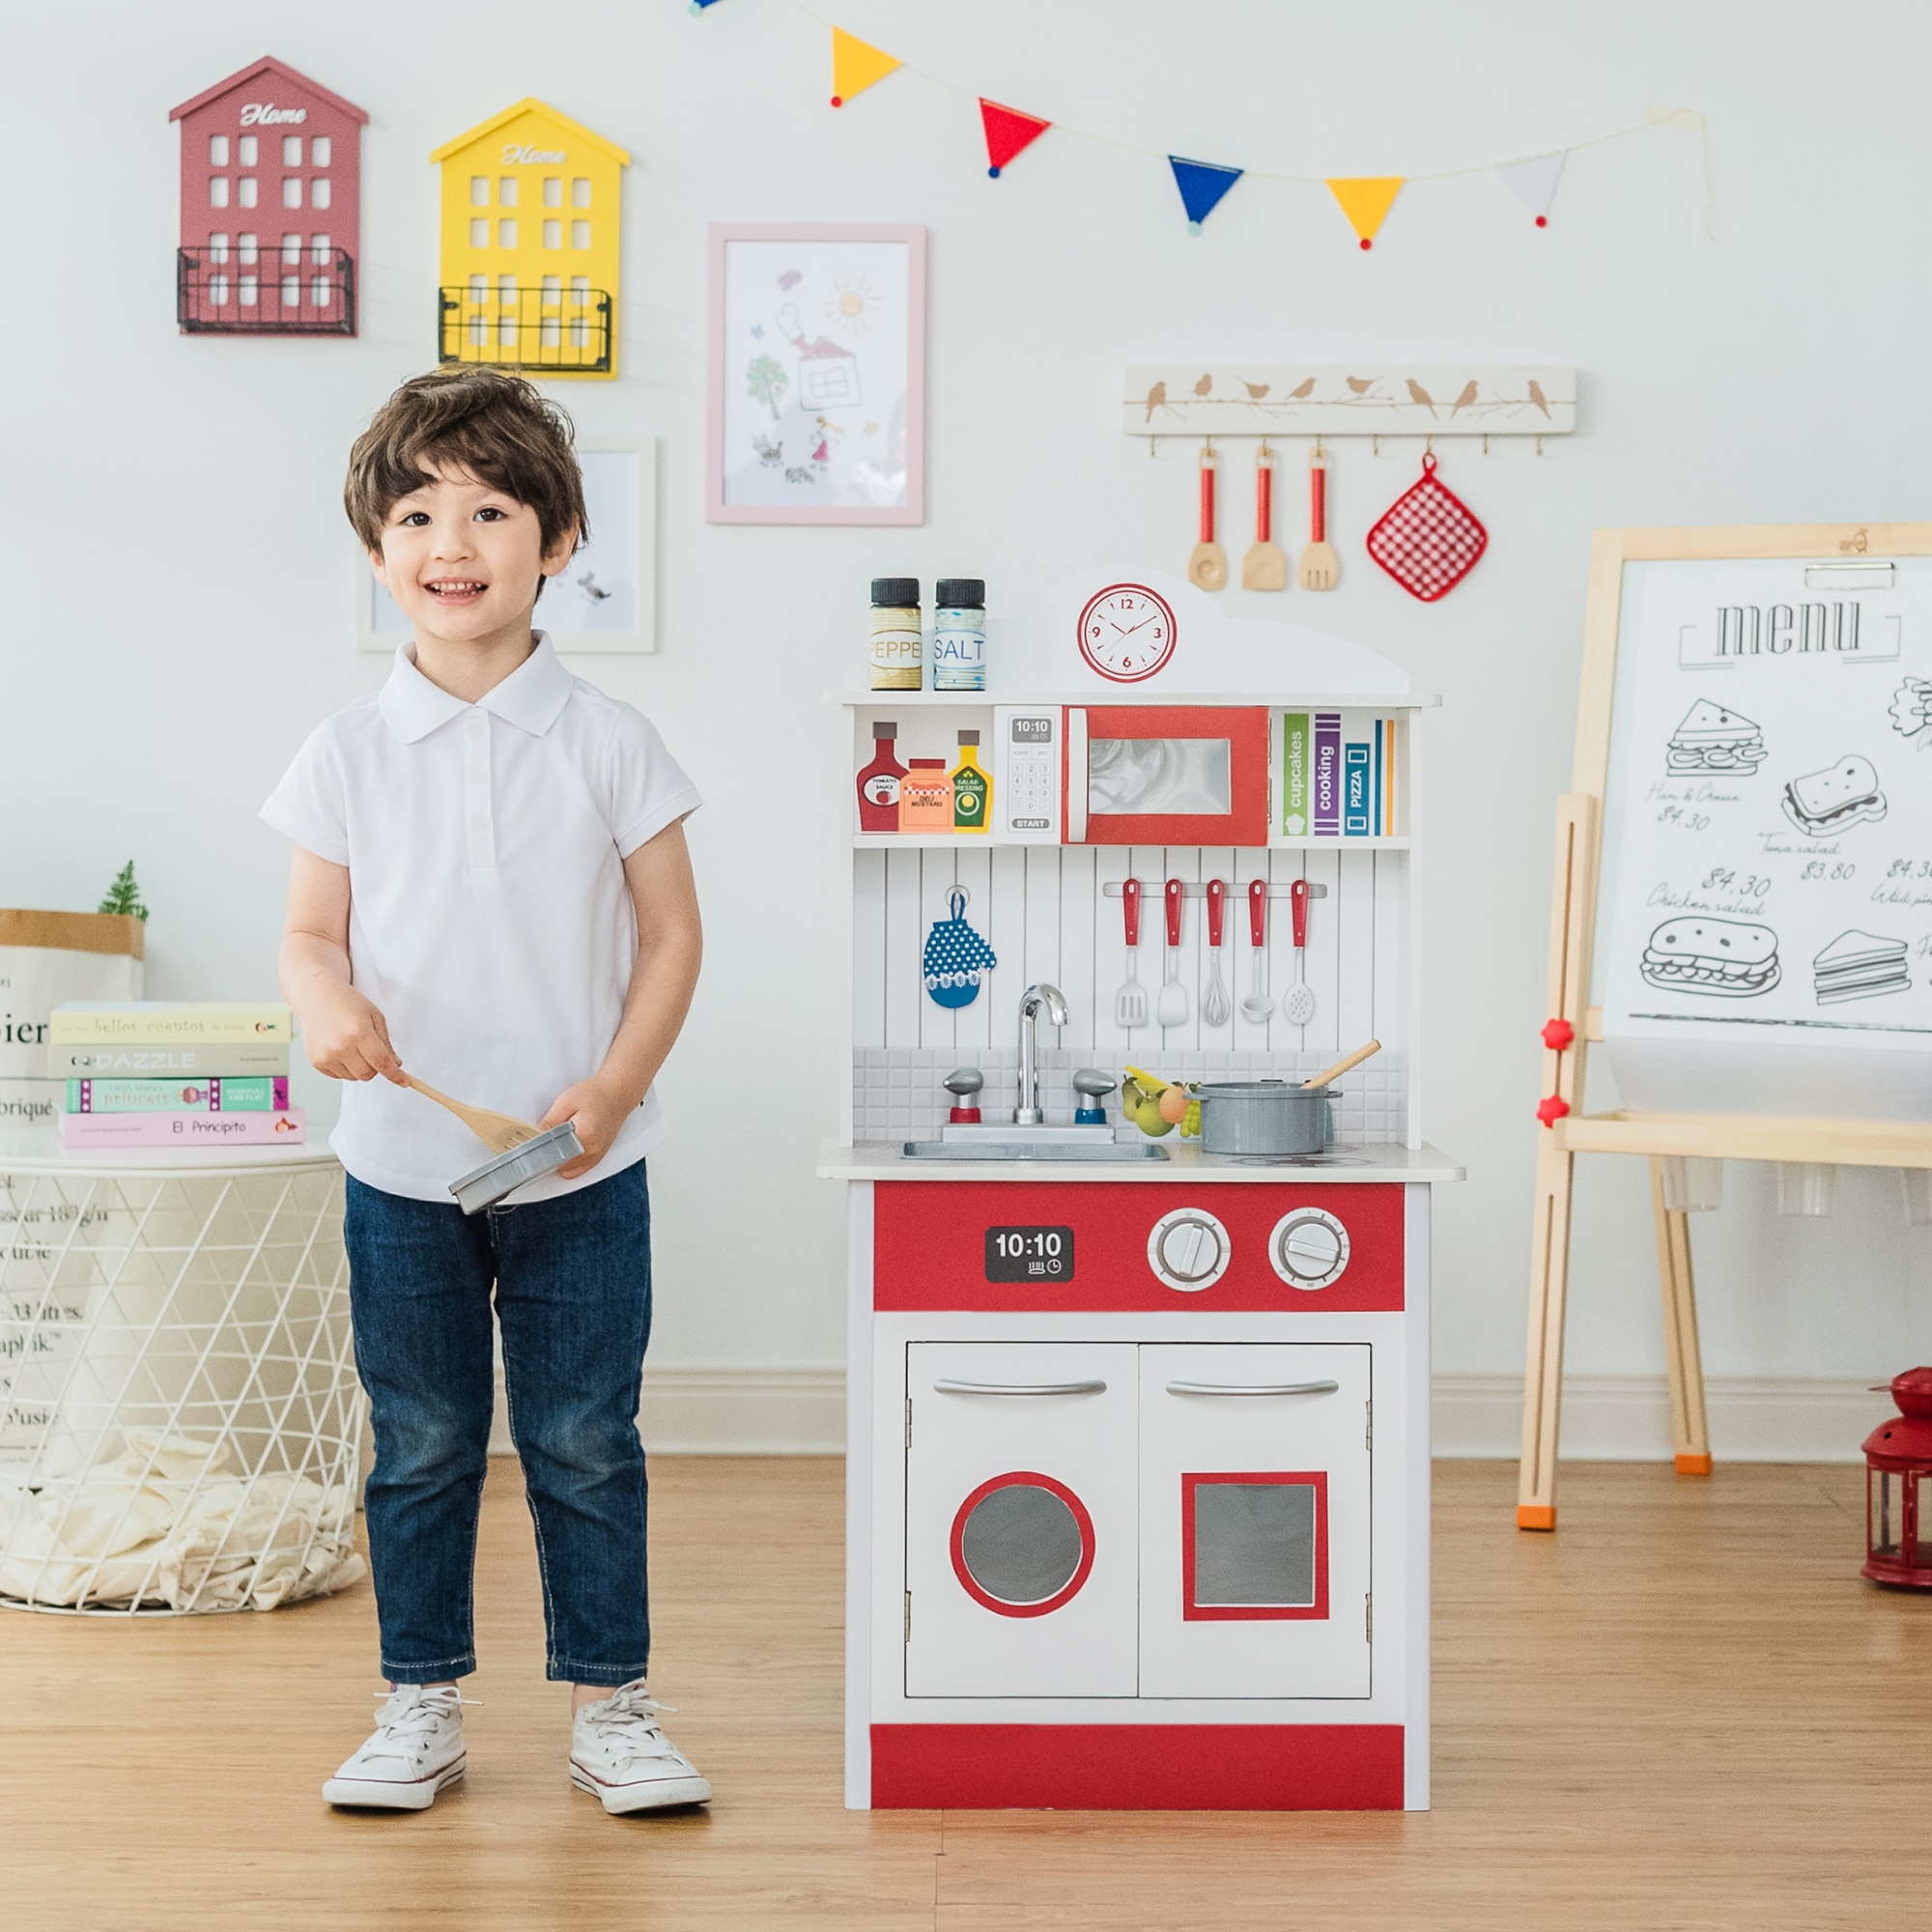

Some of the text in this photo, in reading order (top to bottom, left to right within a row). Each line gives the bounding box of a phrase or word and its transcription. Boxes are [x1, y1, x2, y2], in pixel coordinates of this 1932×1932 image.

[240, 102, 307, 127] Home
[500, 143, 567, 165] Home
[1121, 598, 1134, 610] 12
[1092, 626, 1101, 639] 9
[1153, 627, 1162, 639] 3
[1715, 602, 1861, 657] menu
[870, 641, 922, 659] EPPE
[934, 639, 984, 660] SALT
[1122, 656, 1132, 668] 6
[1016, 721, 1048, 732] 10:10
[1289, 730, 1304, 809] cupcakes
[1318, 745, 1335, 811] cooking
[1350, 769, 1362, 809] PIZZA
[1016, 819, 1045, 828] START
[1658, 806, 1710, 831] $4.30
[1797, 841, 1840, 855] salad
[1801, 861, 1856, 880] $3.80
[1702, 867, 1771, 897] $4.30
[1647, 882, 1767, 916] Chicken salad
[95, 1017, 137, 1034] bellos
[96, 1052, 197, 1070] DAZZLE
[103, 1092, 169, 1108] princess
[173, 1121, 246, 1136] El Principito
[996, 1233, 1062, 1257] 10:10
